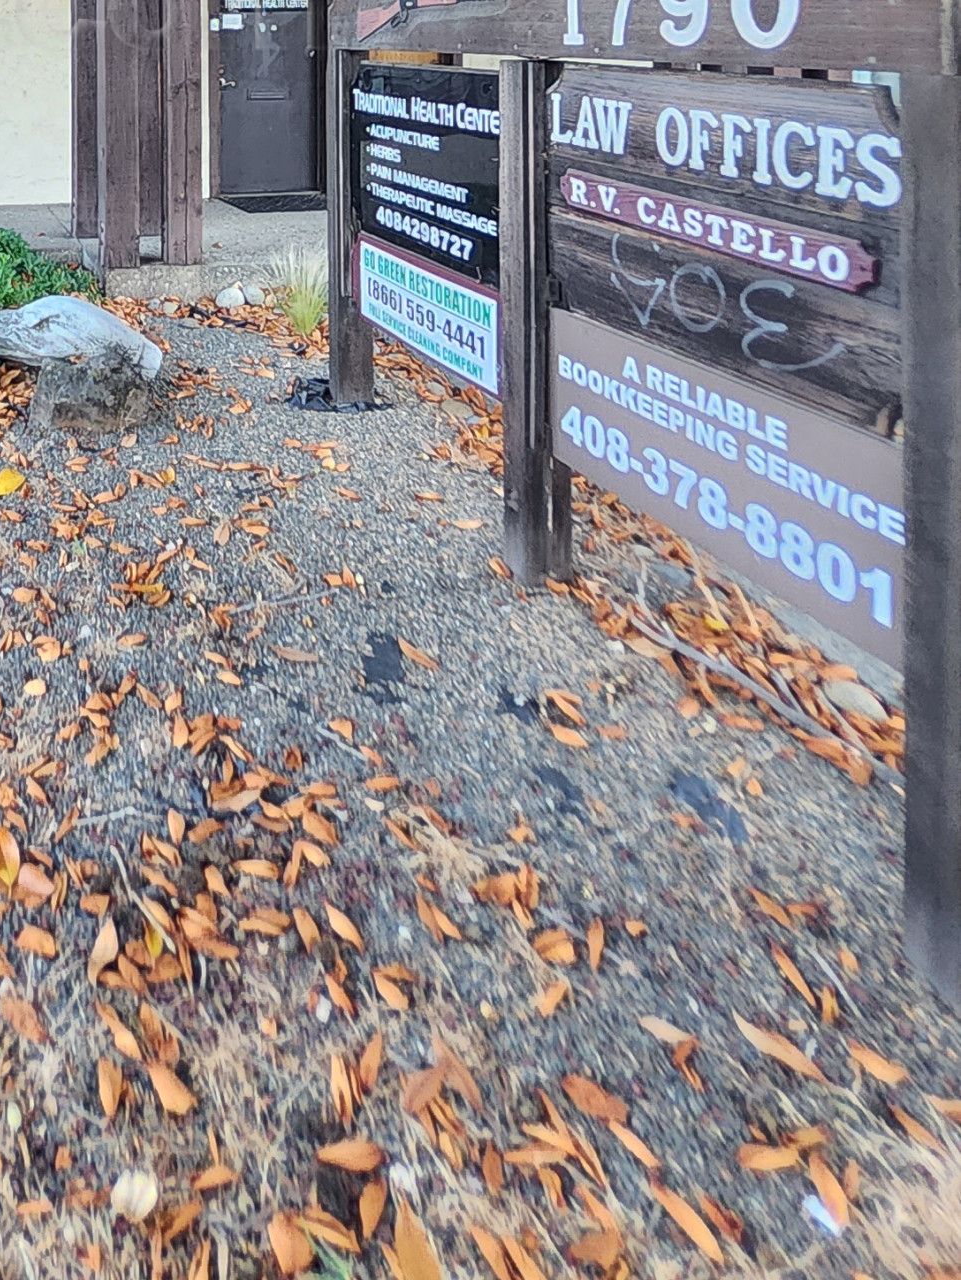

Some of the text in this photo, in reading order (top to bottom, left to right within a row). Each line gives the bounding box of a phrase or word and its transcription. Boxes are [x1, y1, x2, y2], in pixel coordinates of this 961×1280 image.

[352, 88, 501, 135] TRADITIONAL HEALTH CENTE
[369, 123, 440, 152] ACUPUNCTURE
[370, 144, 402, 163] HERBS
[549, 91, 904, 208] LAW OFFICES
[370, 164, 469, 203] PAIN MANAGEMENT
[370, 182, 498, 237] THERAPEUTIC MASSAGE
[375, 205, 474, 261] 4084298727
[568, 176, 851, 282] R.V. CASTELLO
[363, 248, 492, 329] GO GREEN RESTORATION
[406, 298, 486, 361] 559-4441
[407, 325, 441, 357] CLEANING
[442, 346, 484, 381] COMPANY
[622, 355, 789, 451] A RELIABLE
[557, 353, 907, 547] BOOKKEEPING SERVICE
[560, 405, 894, 629] 408-378-8801
